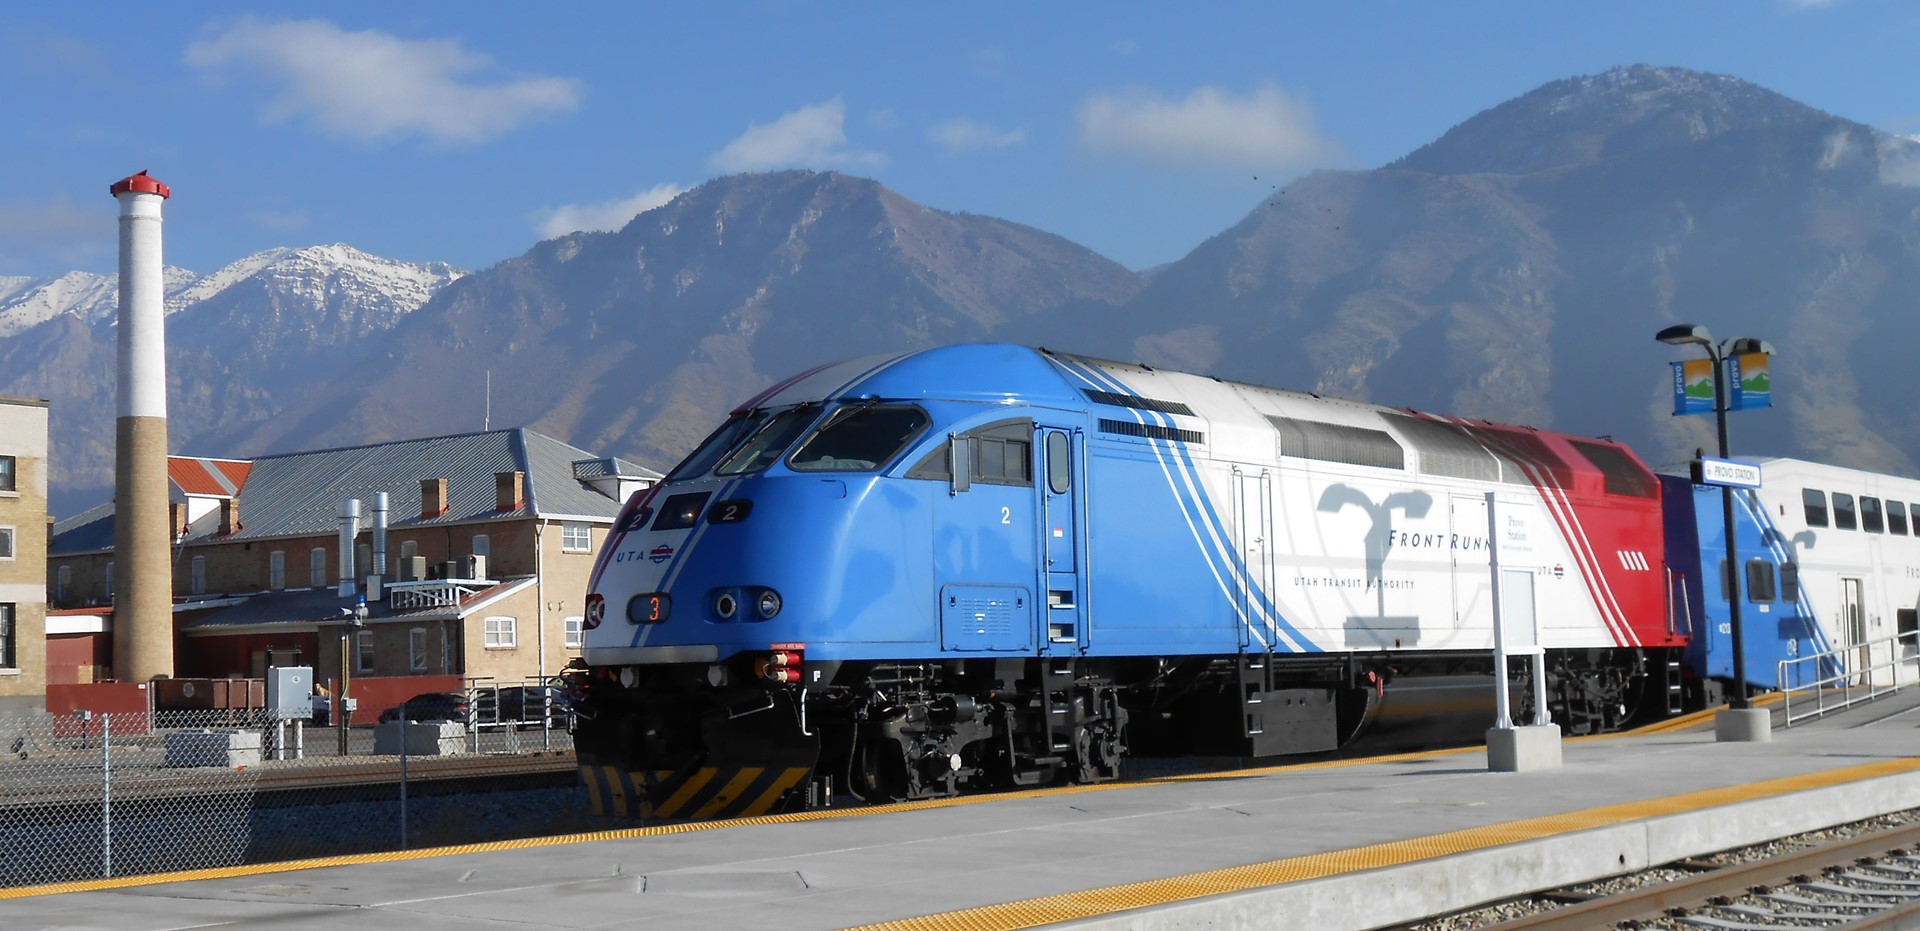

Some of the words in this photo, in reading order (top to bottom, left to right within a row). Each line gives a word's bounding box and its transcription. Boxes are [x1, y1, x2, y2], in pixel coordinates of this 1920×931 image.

[1676, 366, 1684, 394] provo
[1731, 361, 1740, 389] provo
[1715, 465, 1734, 478] PROVO
[1735, 468, 1755, 480] STATION
[722, 505, 738, 520] 2
[1001, 506, 1010, 524] 2
[629, 513, 643, 528] 2
[1388, 530, 1444, 548] FRONT
[616, 551, 643, 562] UTA
[1294, 577, 1318, 587] UTAH
[1323, 578, 1361, 588] TRANSIT
[1367, 579, 1415, 589] AUTHORITY
[650, 597, 659, 620] 3
[813, 670, 821, 682] F
